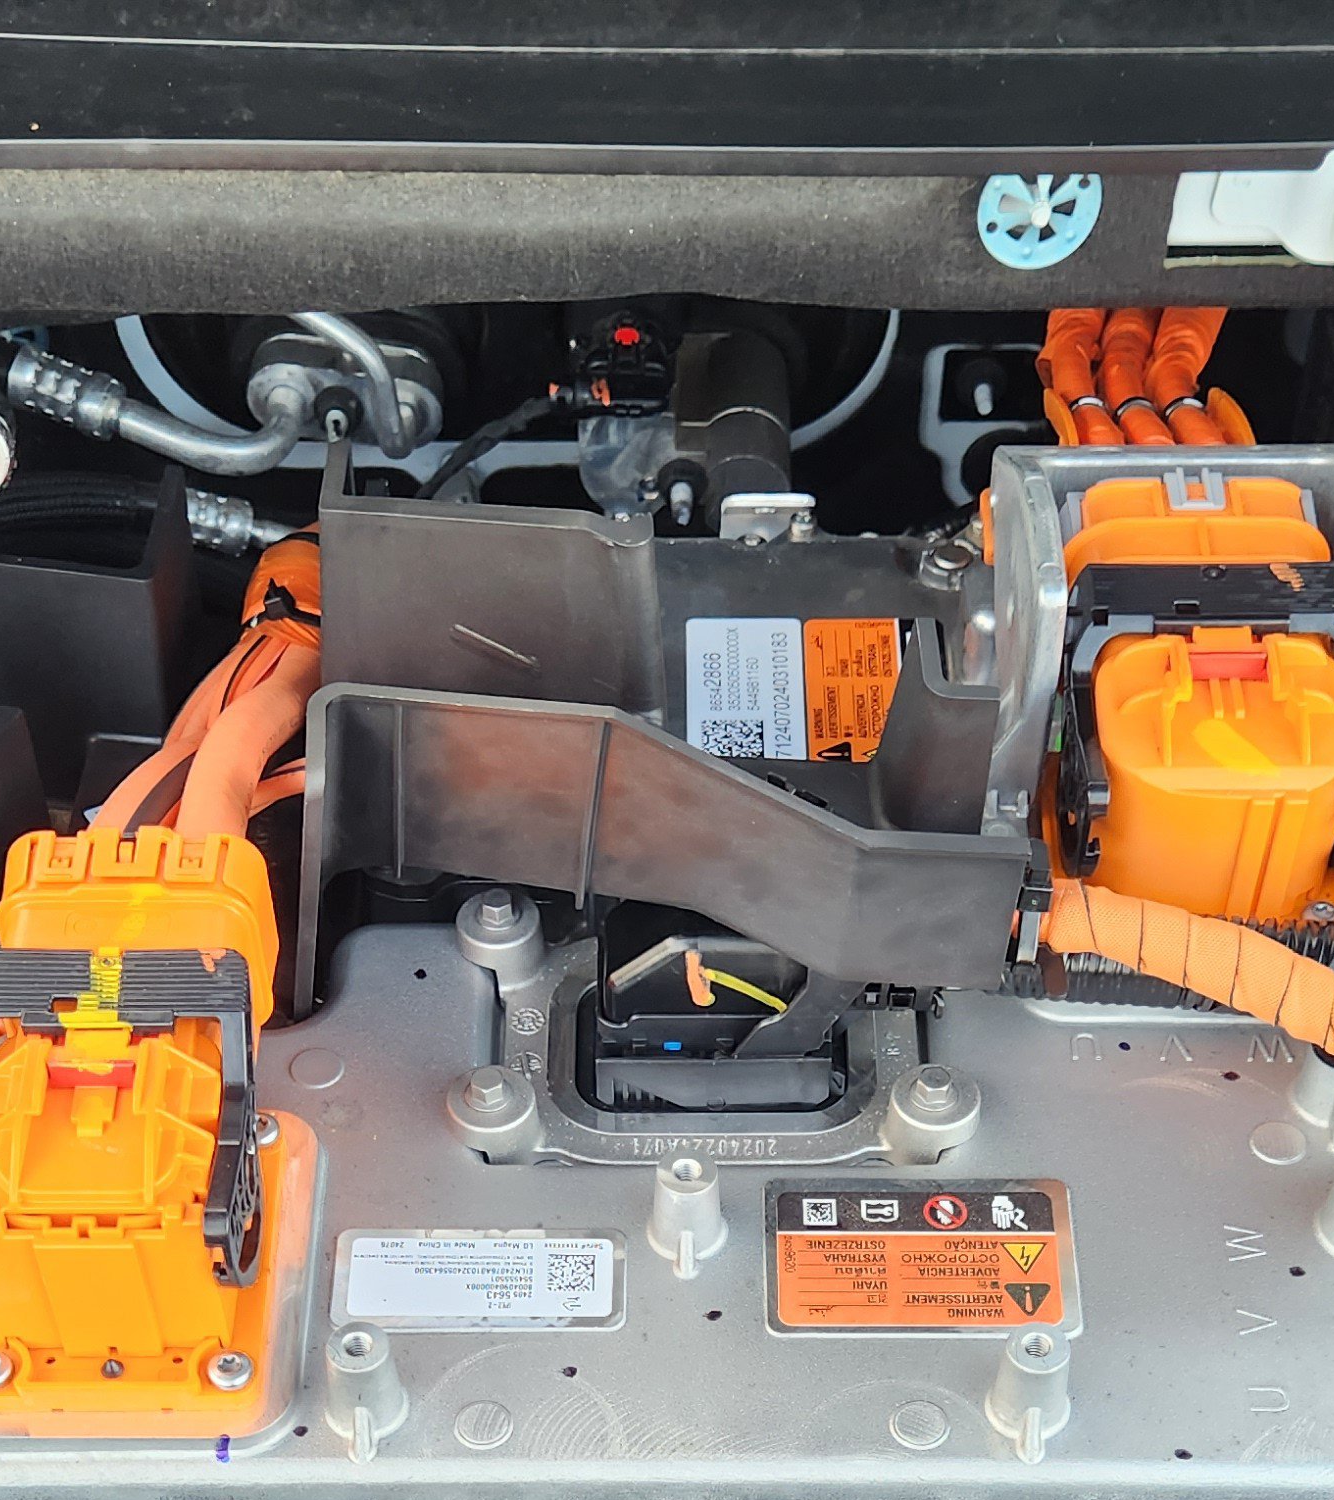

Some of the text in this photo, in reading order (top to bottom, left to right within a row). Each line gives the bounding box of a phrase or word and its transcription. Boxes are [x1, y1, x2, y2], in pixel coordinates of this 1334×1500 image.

[1069, 1033, 1294, 1062] W V U
[944, 1238, 998, 1251] ATENÇÃO
[901, 1253, 1000, 1263] ОСТОРОЖНО
[917, 1267, 1000, 1277] ADVERTENCIA
[852, 1280, 888, 1290] UYARI
[905, 1294, 1003, 1304] AVERTISSEMENT
[947, 1308, 1004, 1318] WARNING
[1222, 1224, 1290, 1413] U V W
